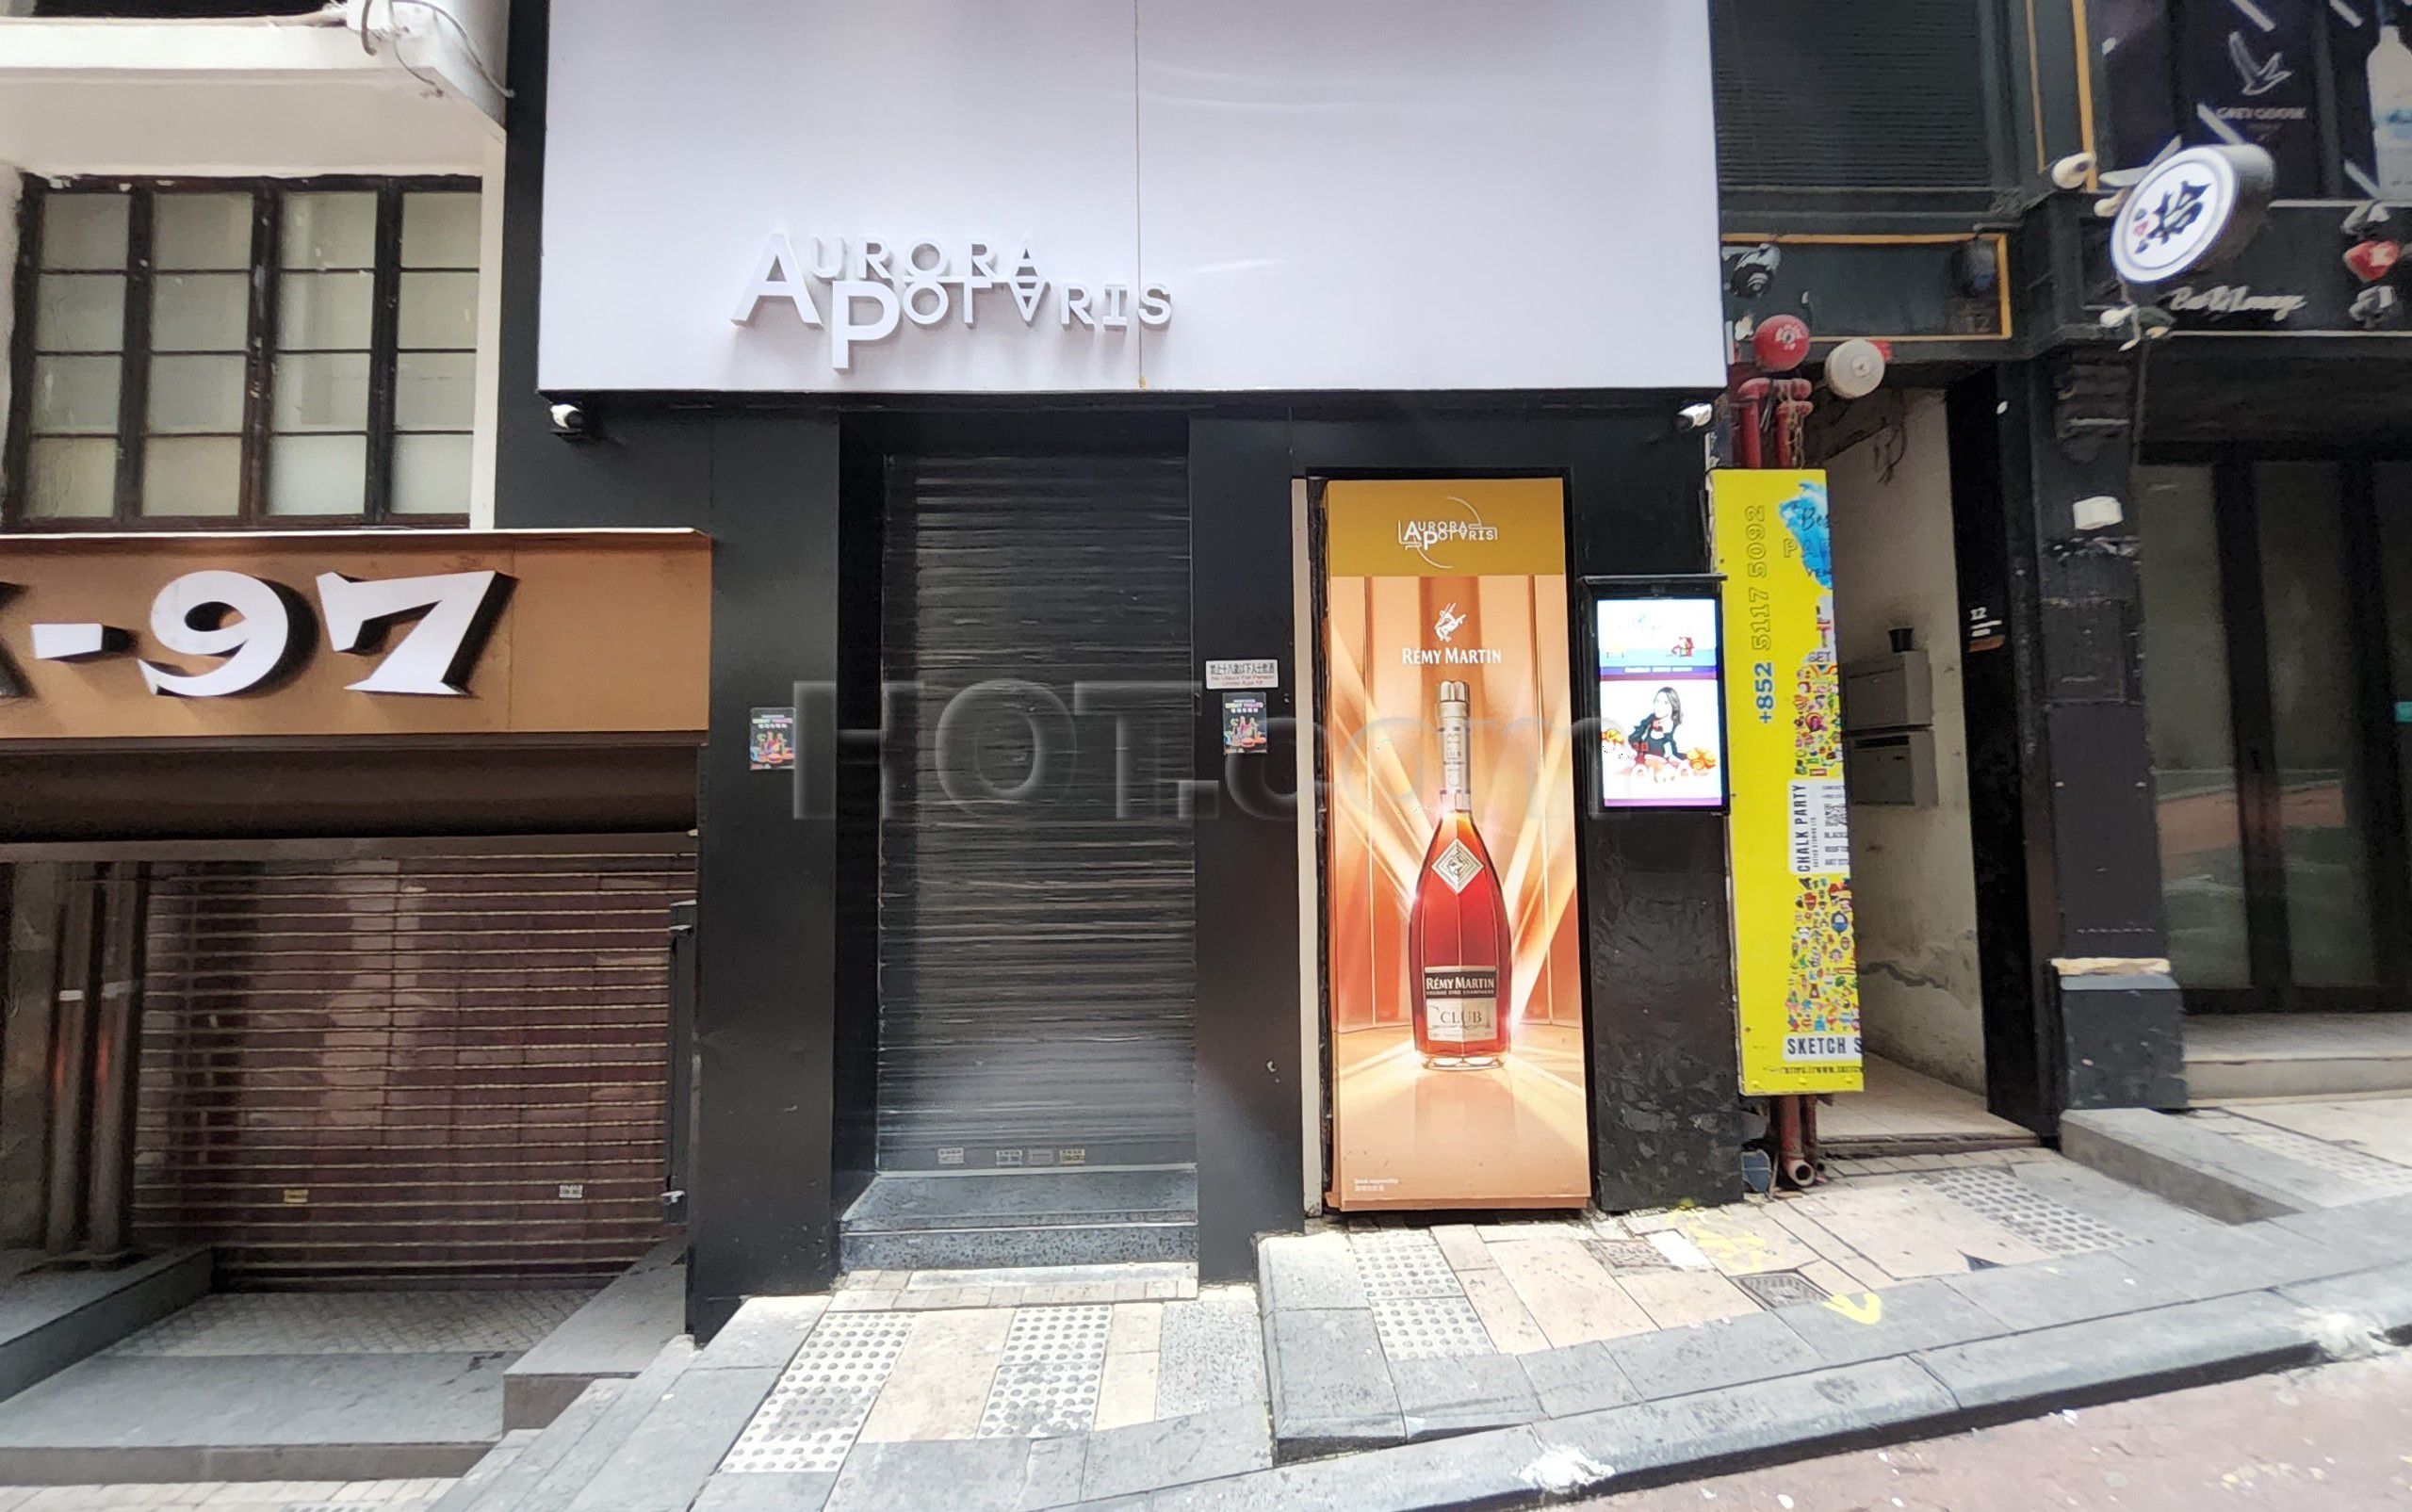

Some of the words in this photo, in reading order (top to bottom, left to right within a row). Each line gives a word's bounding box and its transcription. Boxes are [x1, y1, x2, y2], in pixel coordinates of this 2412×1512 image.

[1744, 504, 1768, 578] 5092
[0, 570, 496, 697] -97
[1748, 586, 1772, 651] 5117
[1402, 647, 1442, 665] RÉMY
[1444, 646, 1502, 664] MARTIN
[1753, 661, 1774, 724] +852
[1792, 785, 1809, 824] PARTY
[1795, 831, 1811, 872] CHALK
[1455, 976, 1494, 989] MARTIN
[1440, 1011, 1482, 1024] CLUB
[1786, 1037, 1847, 1055] SKETCH
